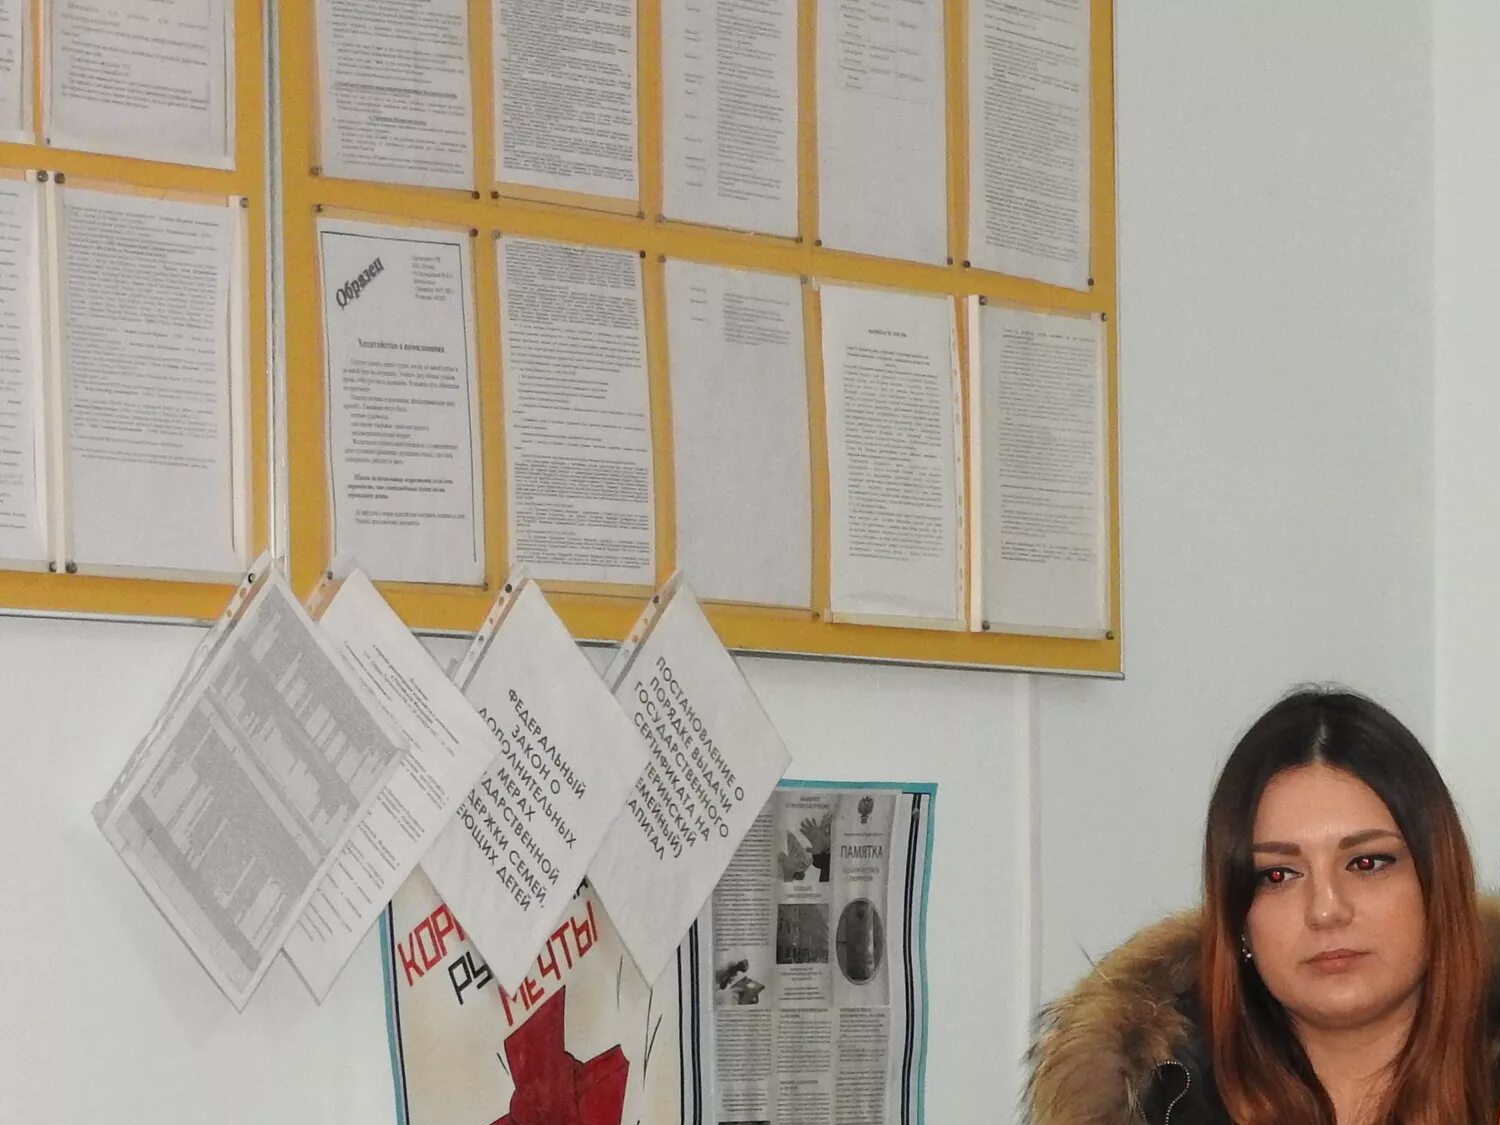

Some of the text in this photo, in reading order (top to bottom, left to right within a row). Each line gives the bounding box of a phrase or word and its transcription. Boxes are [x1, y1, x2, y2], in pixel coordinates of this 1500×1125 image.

[335, 256, 385, 312] Образец
[508, 688, 587, 800] ФЕДЕРАЛЬНЫЙ
[511, 723, 561, 795] ЗАКОН О
[634, 681, 729, 838] ГОСУДАРСТВЕННОГО
[650, 676, 733, 814] ПОРЯДКЕ ВЫДАЧИ
[656, 656, 745, 802] ПОСТАНОВЛЕНИЕ О
[497, 767, 536, 822] МЕРАХ
[634, 712, 711, 843] СЕРТИФИКАТА НА
[480, 771, 560, 886] ДАРСТВЕННОЙ
[626, 799, 665, 861] АПИТАЛ
[840, 844, 884, 860] ПАМЯТКА
[495, 865, 532, 912] ДЕТЕЙ
